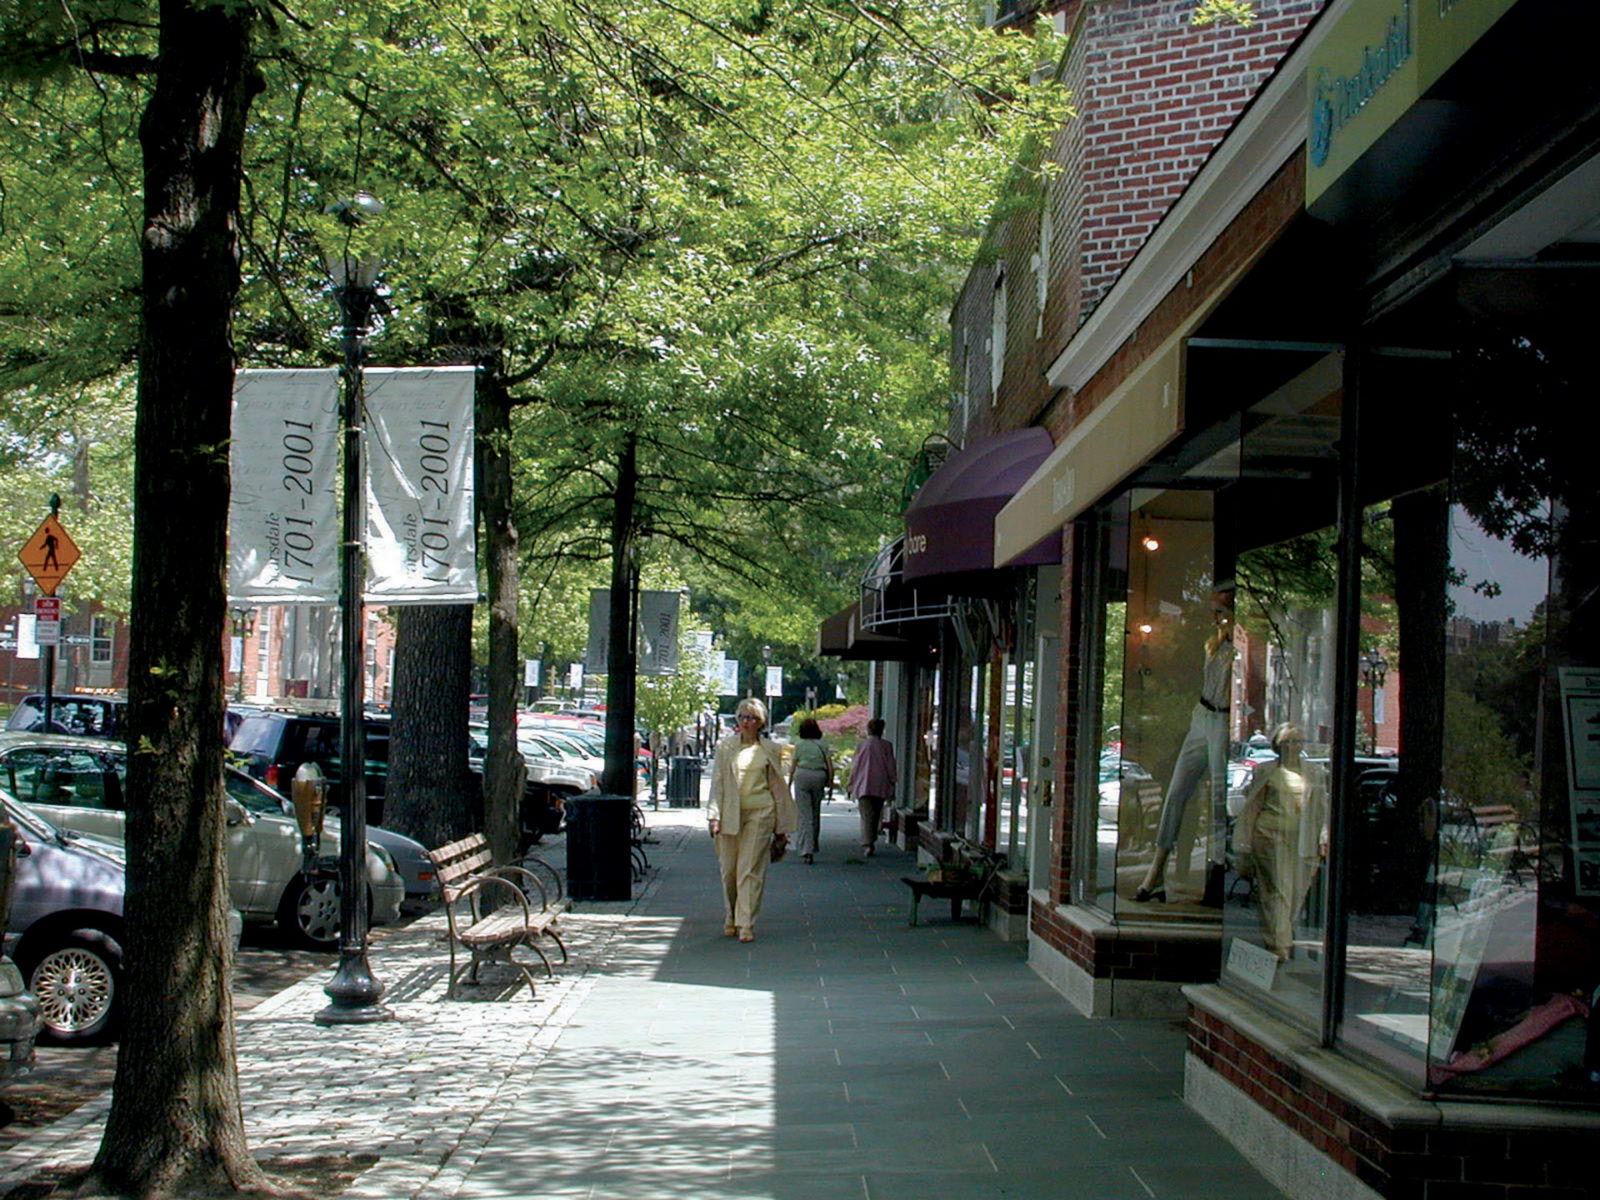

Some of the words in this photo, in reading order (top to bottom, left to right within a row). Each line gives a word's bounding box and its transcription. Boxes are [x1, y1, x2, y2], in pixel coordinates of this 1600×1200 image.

[283, 419, 314, 585] 1701-2001
[403, 512, 417, 575] arsdale
[419, 419, 450, 585] 1701-2001
